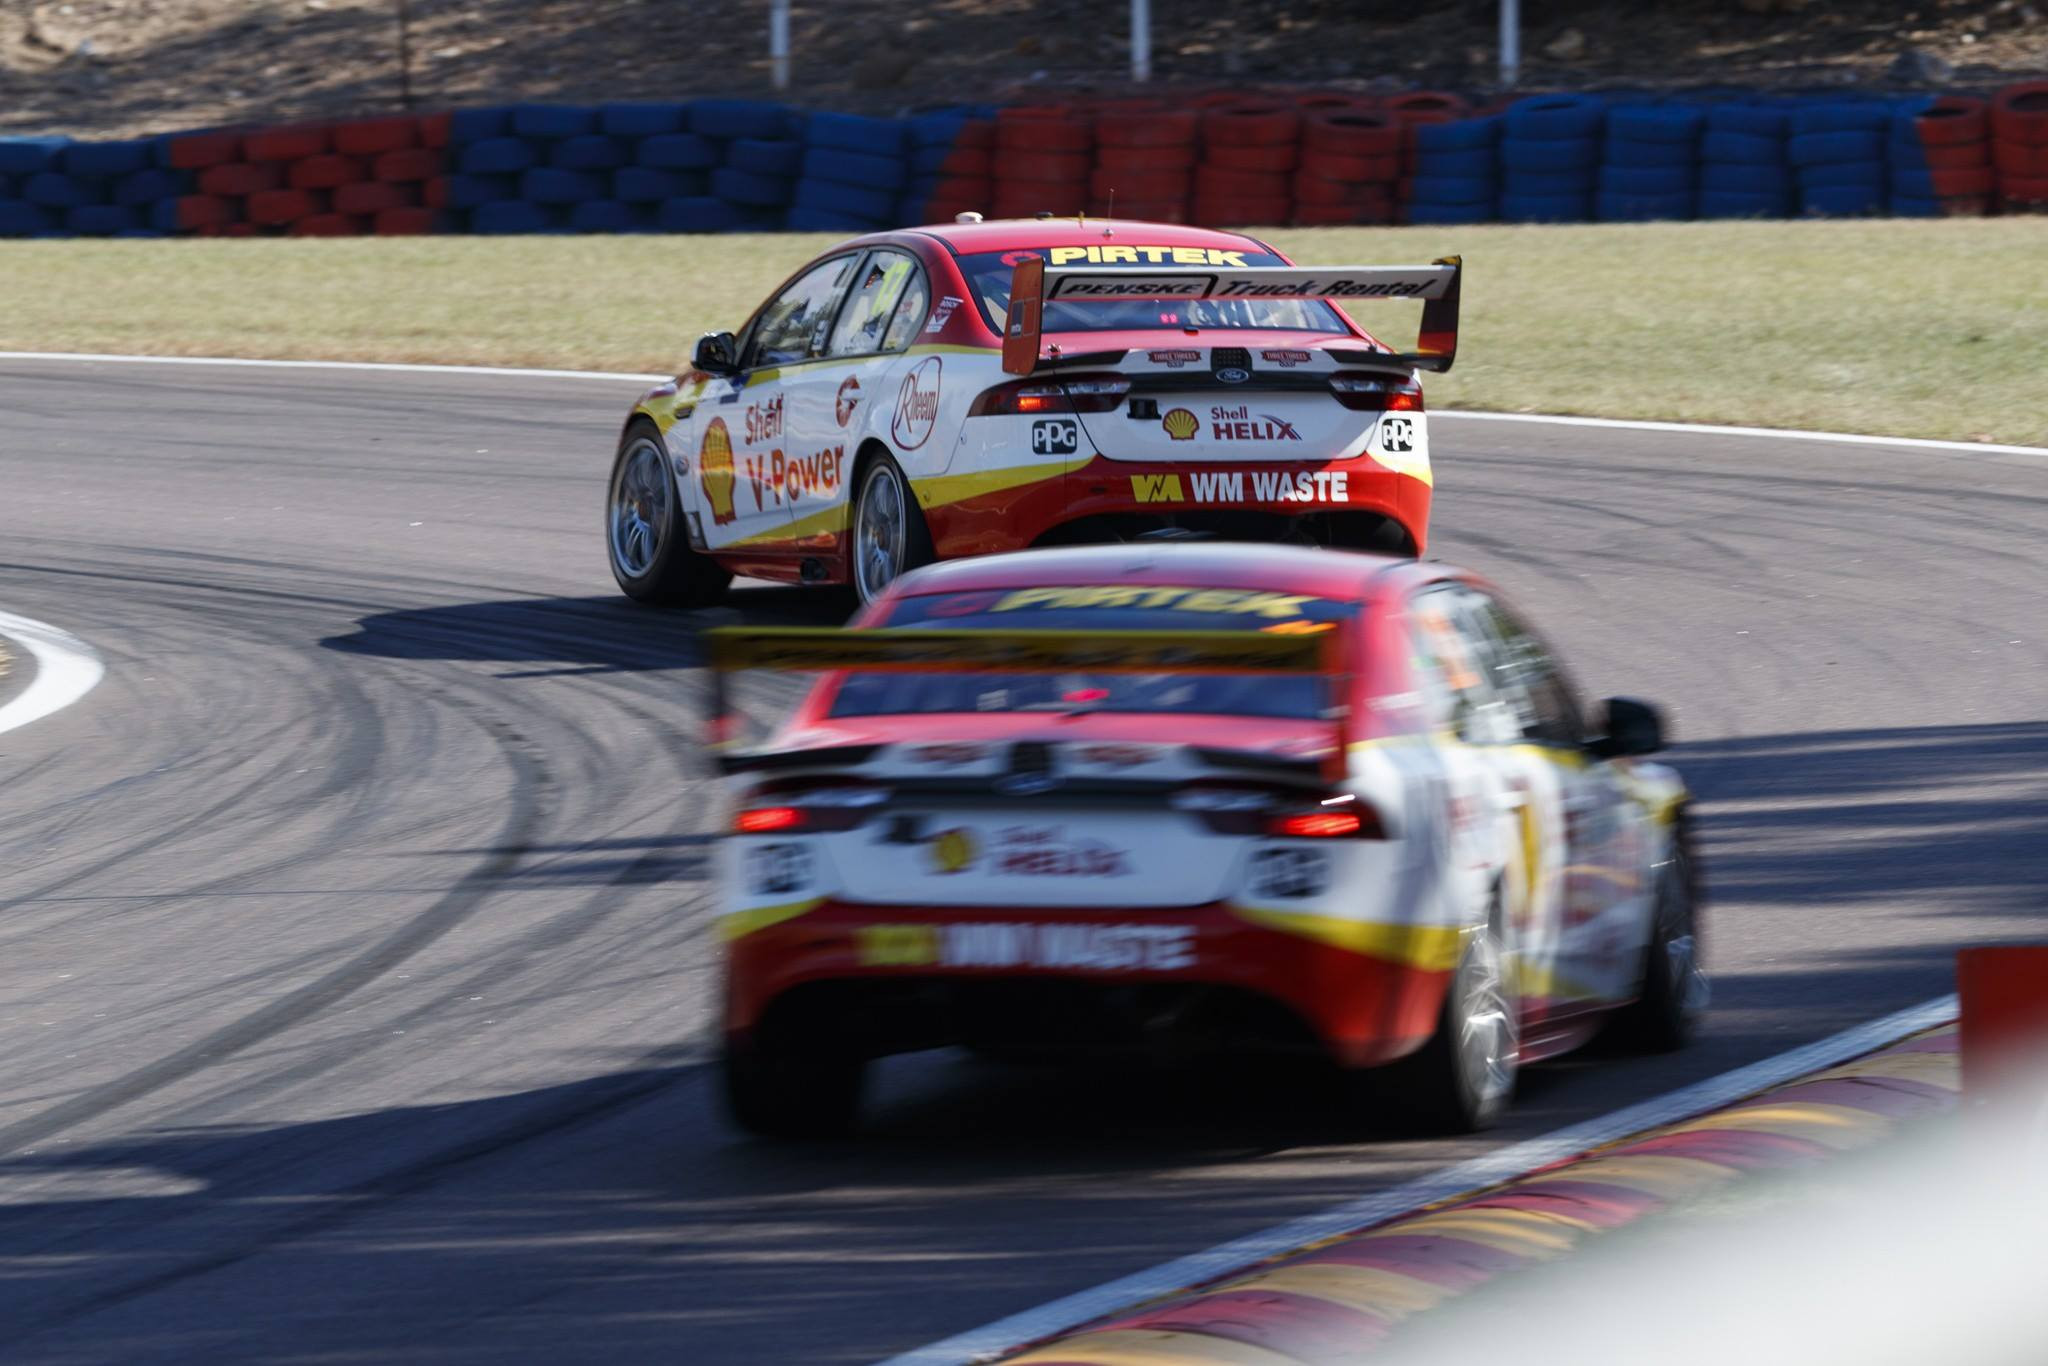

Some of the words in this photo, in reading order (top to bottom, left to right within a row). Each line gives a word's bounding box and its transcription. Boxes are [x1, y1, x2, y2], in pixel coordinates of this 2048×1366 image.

[1051, 246, 1248, 267] PIRTEK
[1063, 283, 1203, 295] PENSKE
[1220, 280, 1318, 296] Truck
[1319, 279, 1438, 296] Rental
[895, 372, 937, 434] Rheem
[1211, 407, 1248, 420] Shell
[745, 392, 784, 445] Shell
[1212, 423, 1299, 441] HELIX
[1033, 422, 1077, 453] PPG
[1382, 419, 1414, 451] PPG
[746, 445, 845, 512] V-Power
[1190, 472, 1243, 502] WM
[1251, 472, 1349, 502] WASTE
